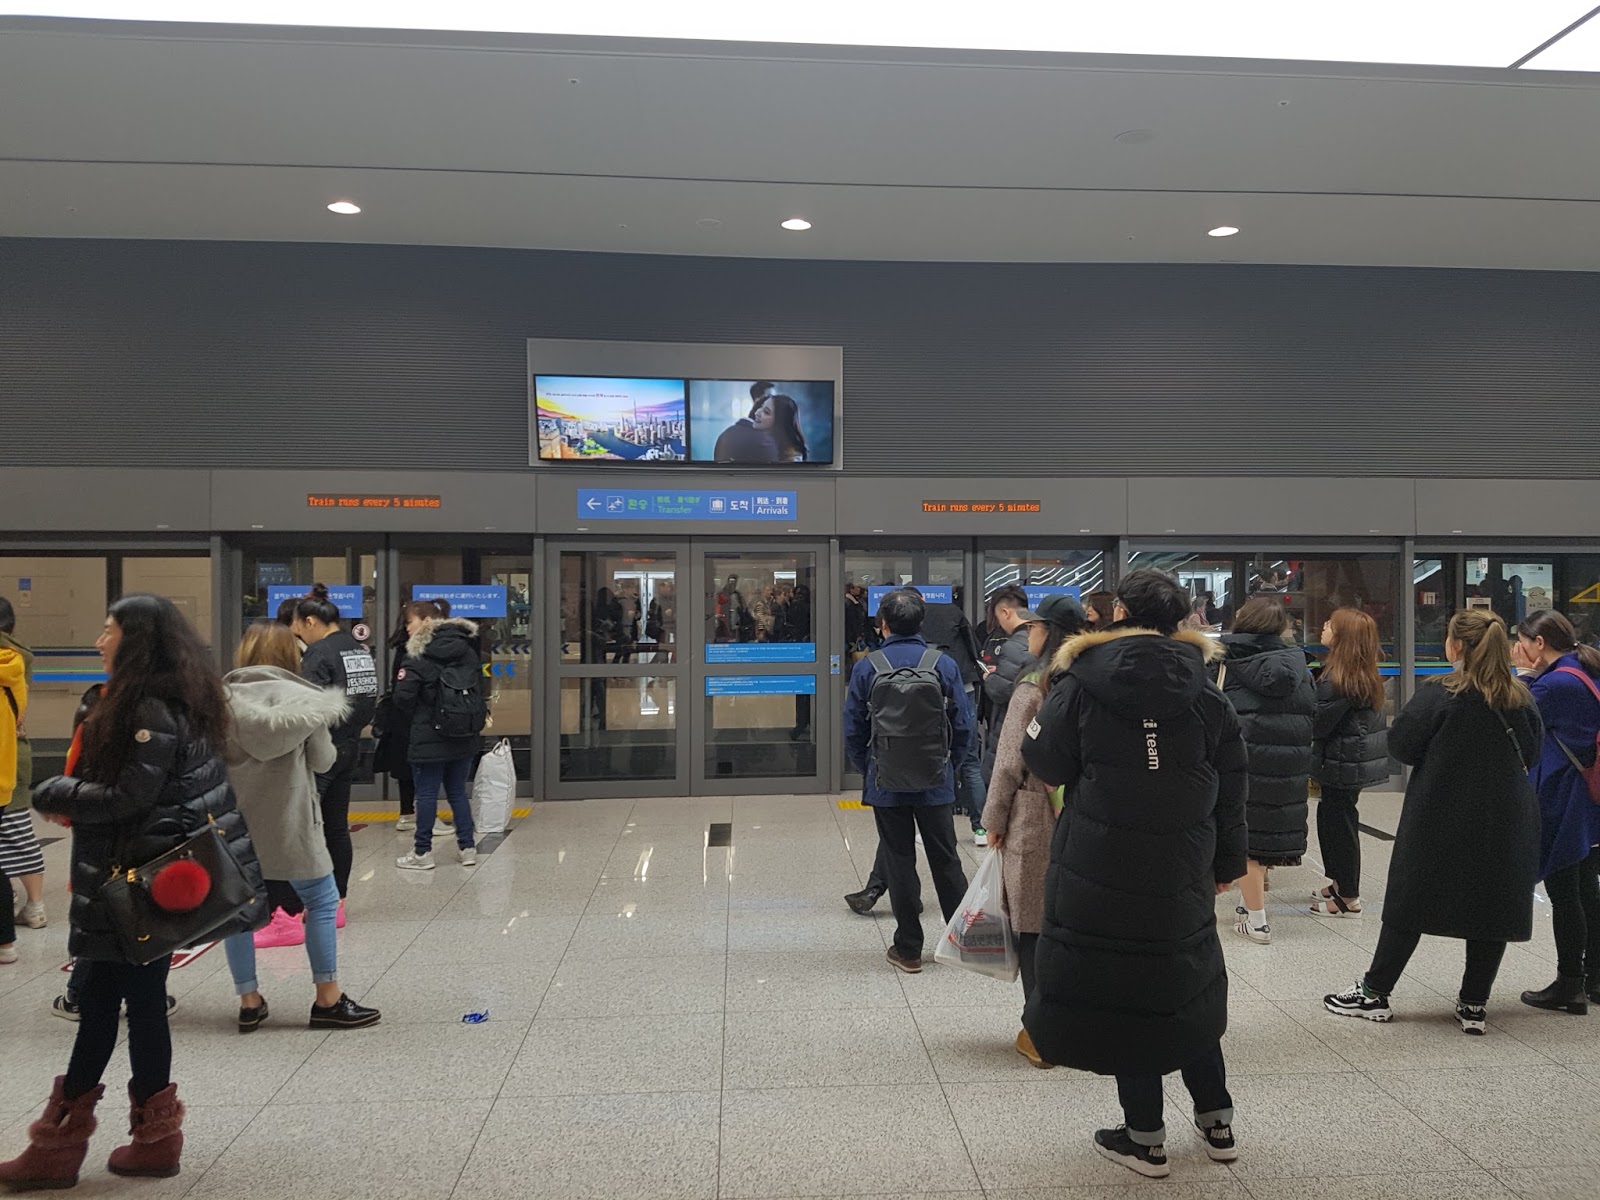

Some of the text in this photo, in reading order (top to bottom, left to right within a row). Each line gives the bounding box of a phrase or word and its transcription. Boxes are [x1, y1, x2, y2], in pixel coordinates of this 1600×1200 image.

[308, 497, 440, 508] Train runs every 5 minutes
[730, 500, 749, 511] 도착
[922, 503, 1040, 513] Train runs every 5 minutes
[657, 505, 692, 514] Transfer
[756, 506, 788, 515] Arrivals
[1146, 733, 1159, 769] team
[1210, 1126, 1230, 1139] NIKE
